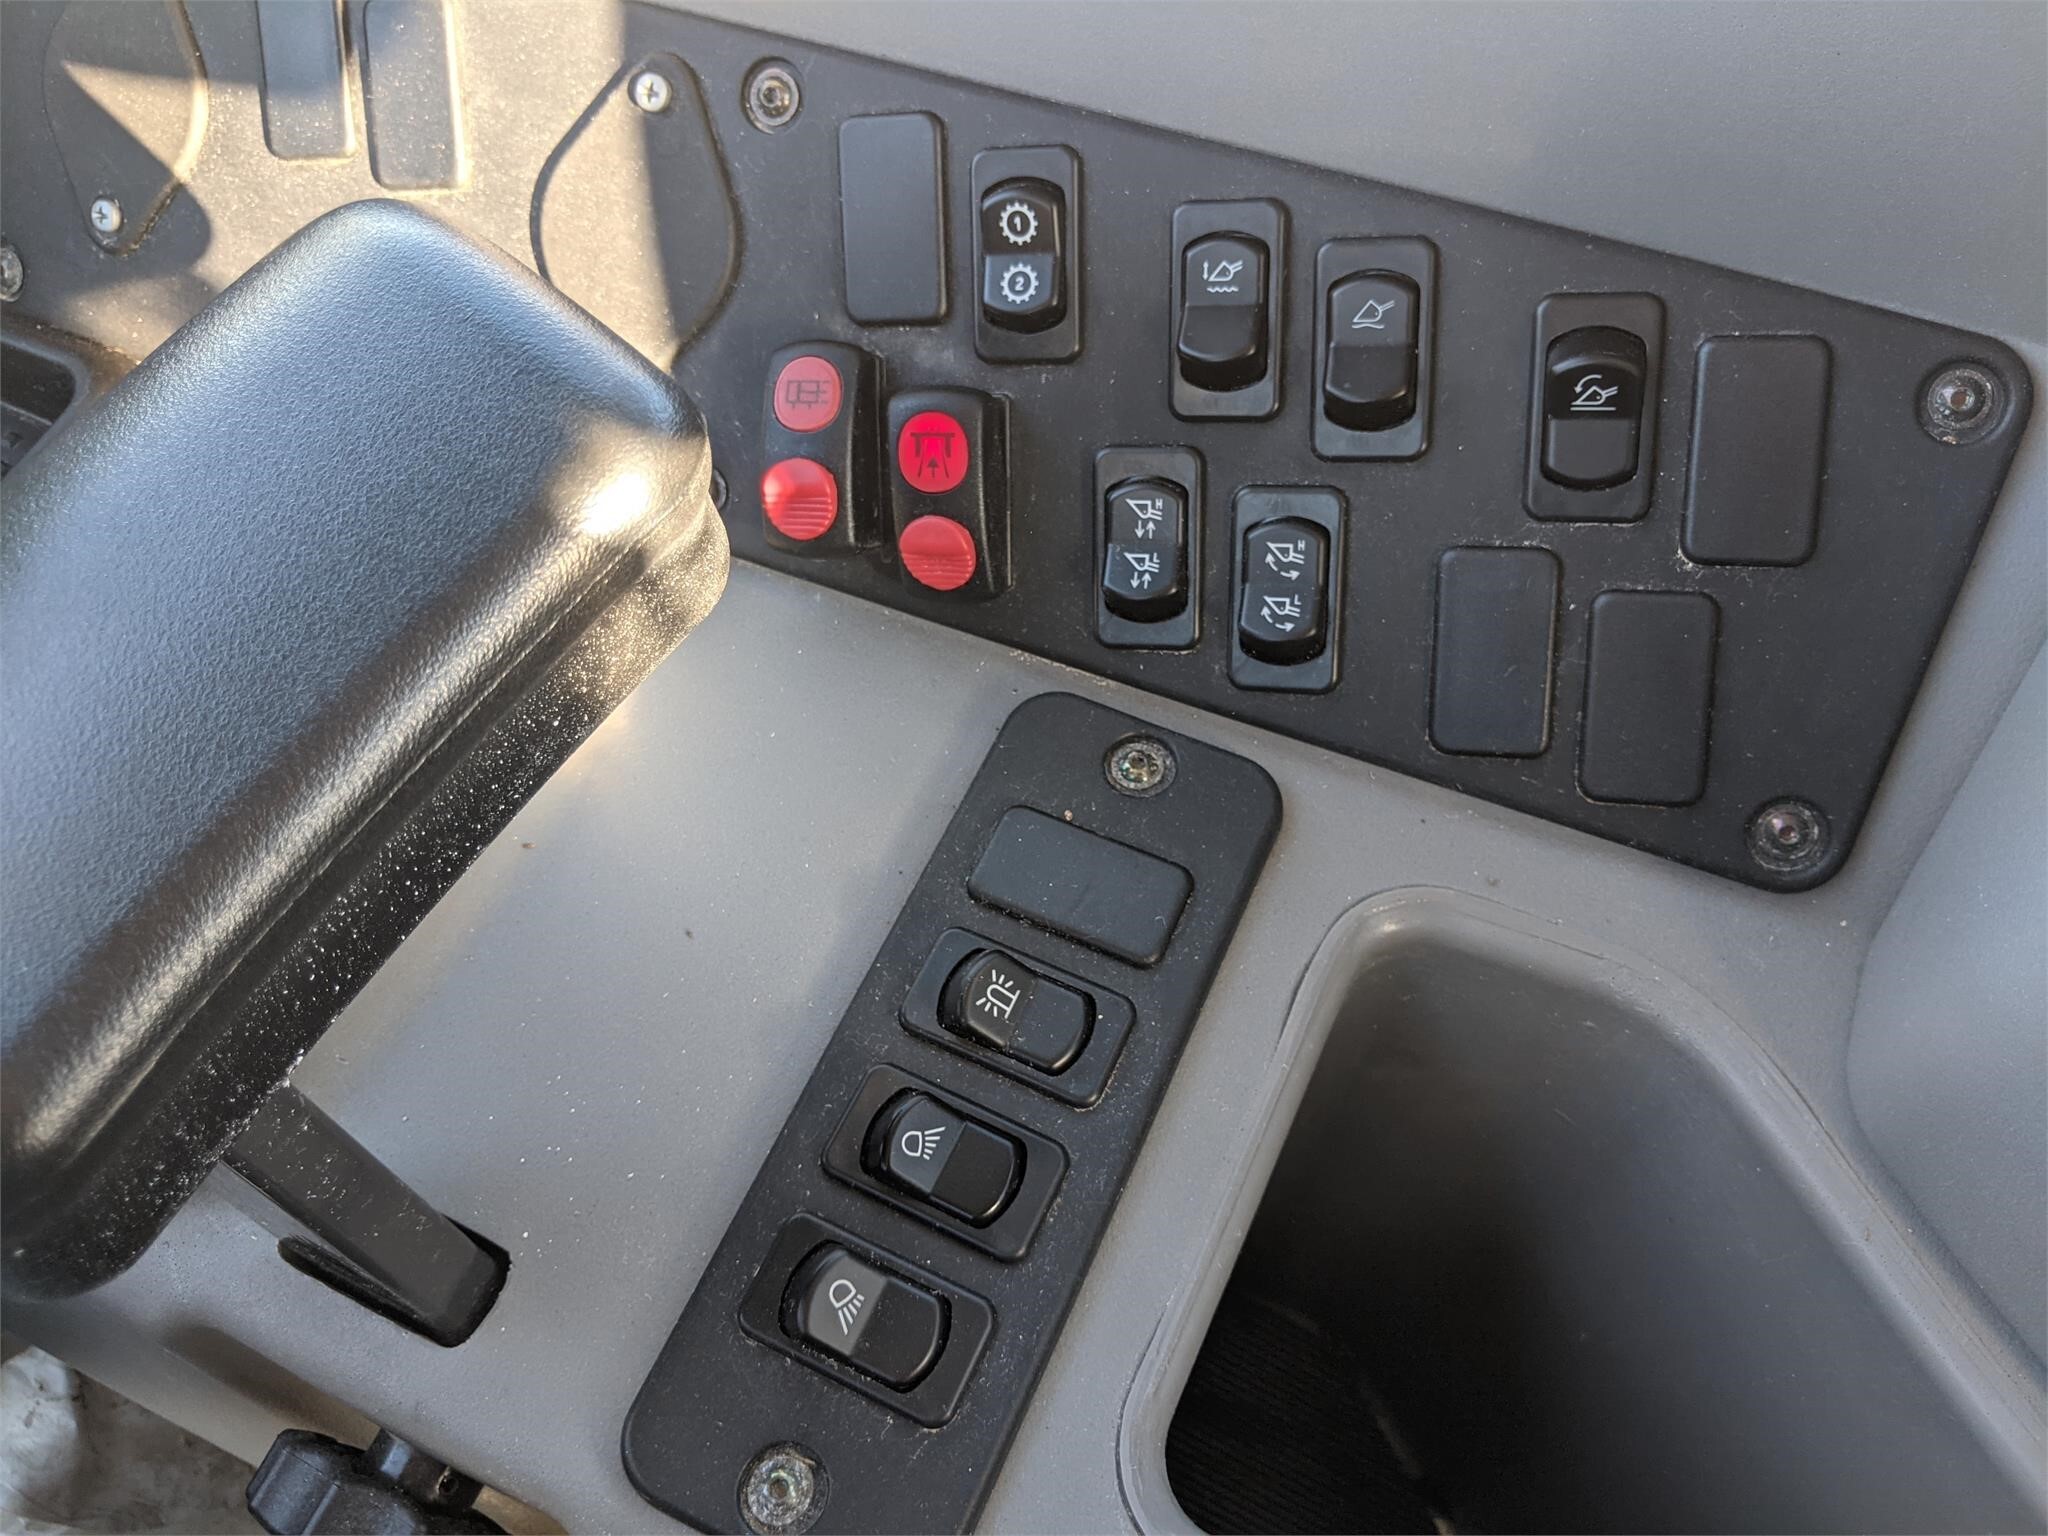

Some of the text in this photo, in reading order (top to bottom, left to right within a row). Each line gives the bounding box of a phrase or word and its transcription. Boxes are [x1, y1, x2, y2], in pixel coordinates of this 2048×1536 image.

[1013, 215, 1022, 232] 1
[1014, 275, 1025, 291] 2
[1155, 498, 1163, 510] H
[1297, 539, 1306, 551] H
